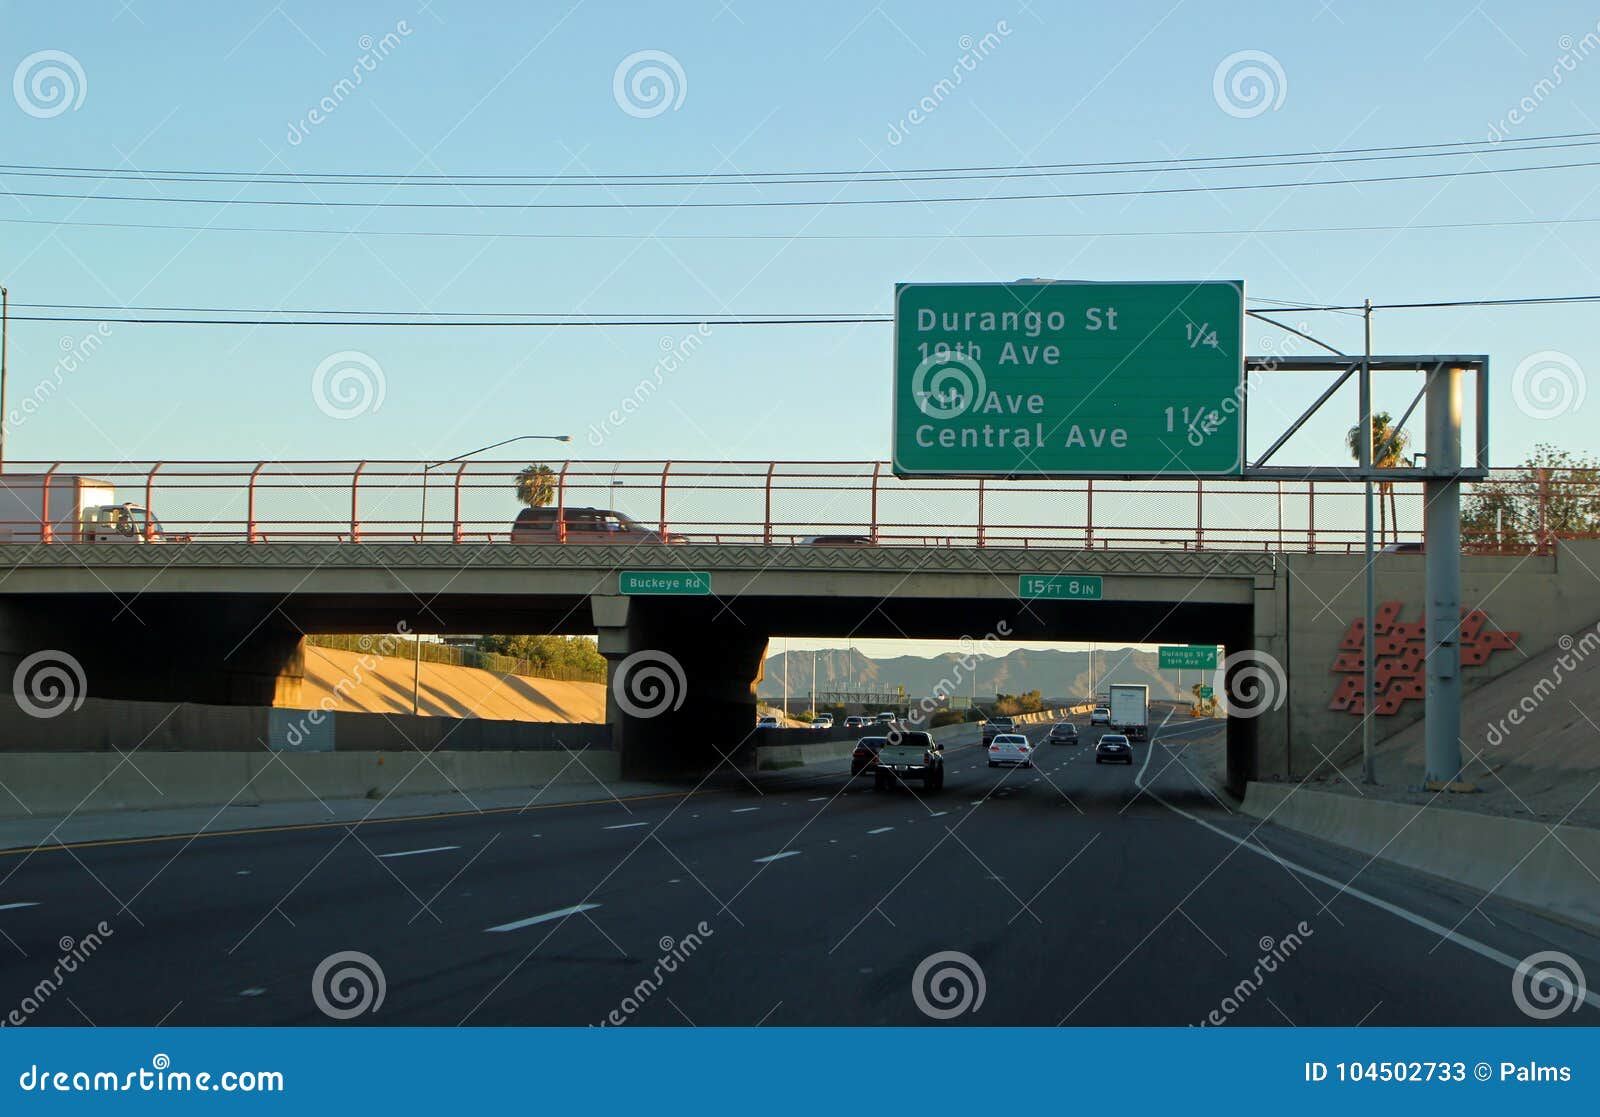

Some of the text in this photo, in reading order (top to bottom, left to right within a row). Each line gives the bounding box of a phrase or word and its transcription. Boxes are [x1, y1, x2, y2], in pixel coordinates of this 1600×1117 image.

[917, 307, 1118, 337] Durango St
[917, 340, 1060, 365] 19th Ave
[916, 386, 1045, 414] 7th Ave
[915, 422, 1129, 449] Central Ave
[630, 578, 700, 590] Buckeye Rd
